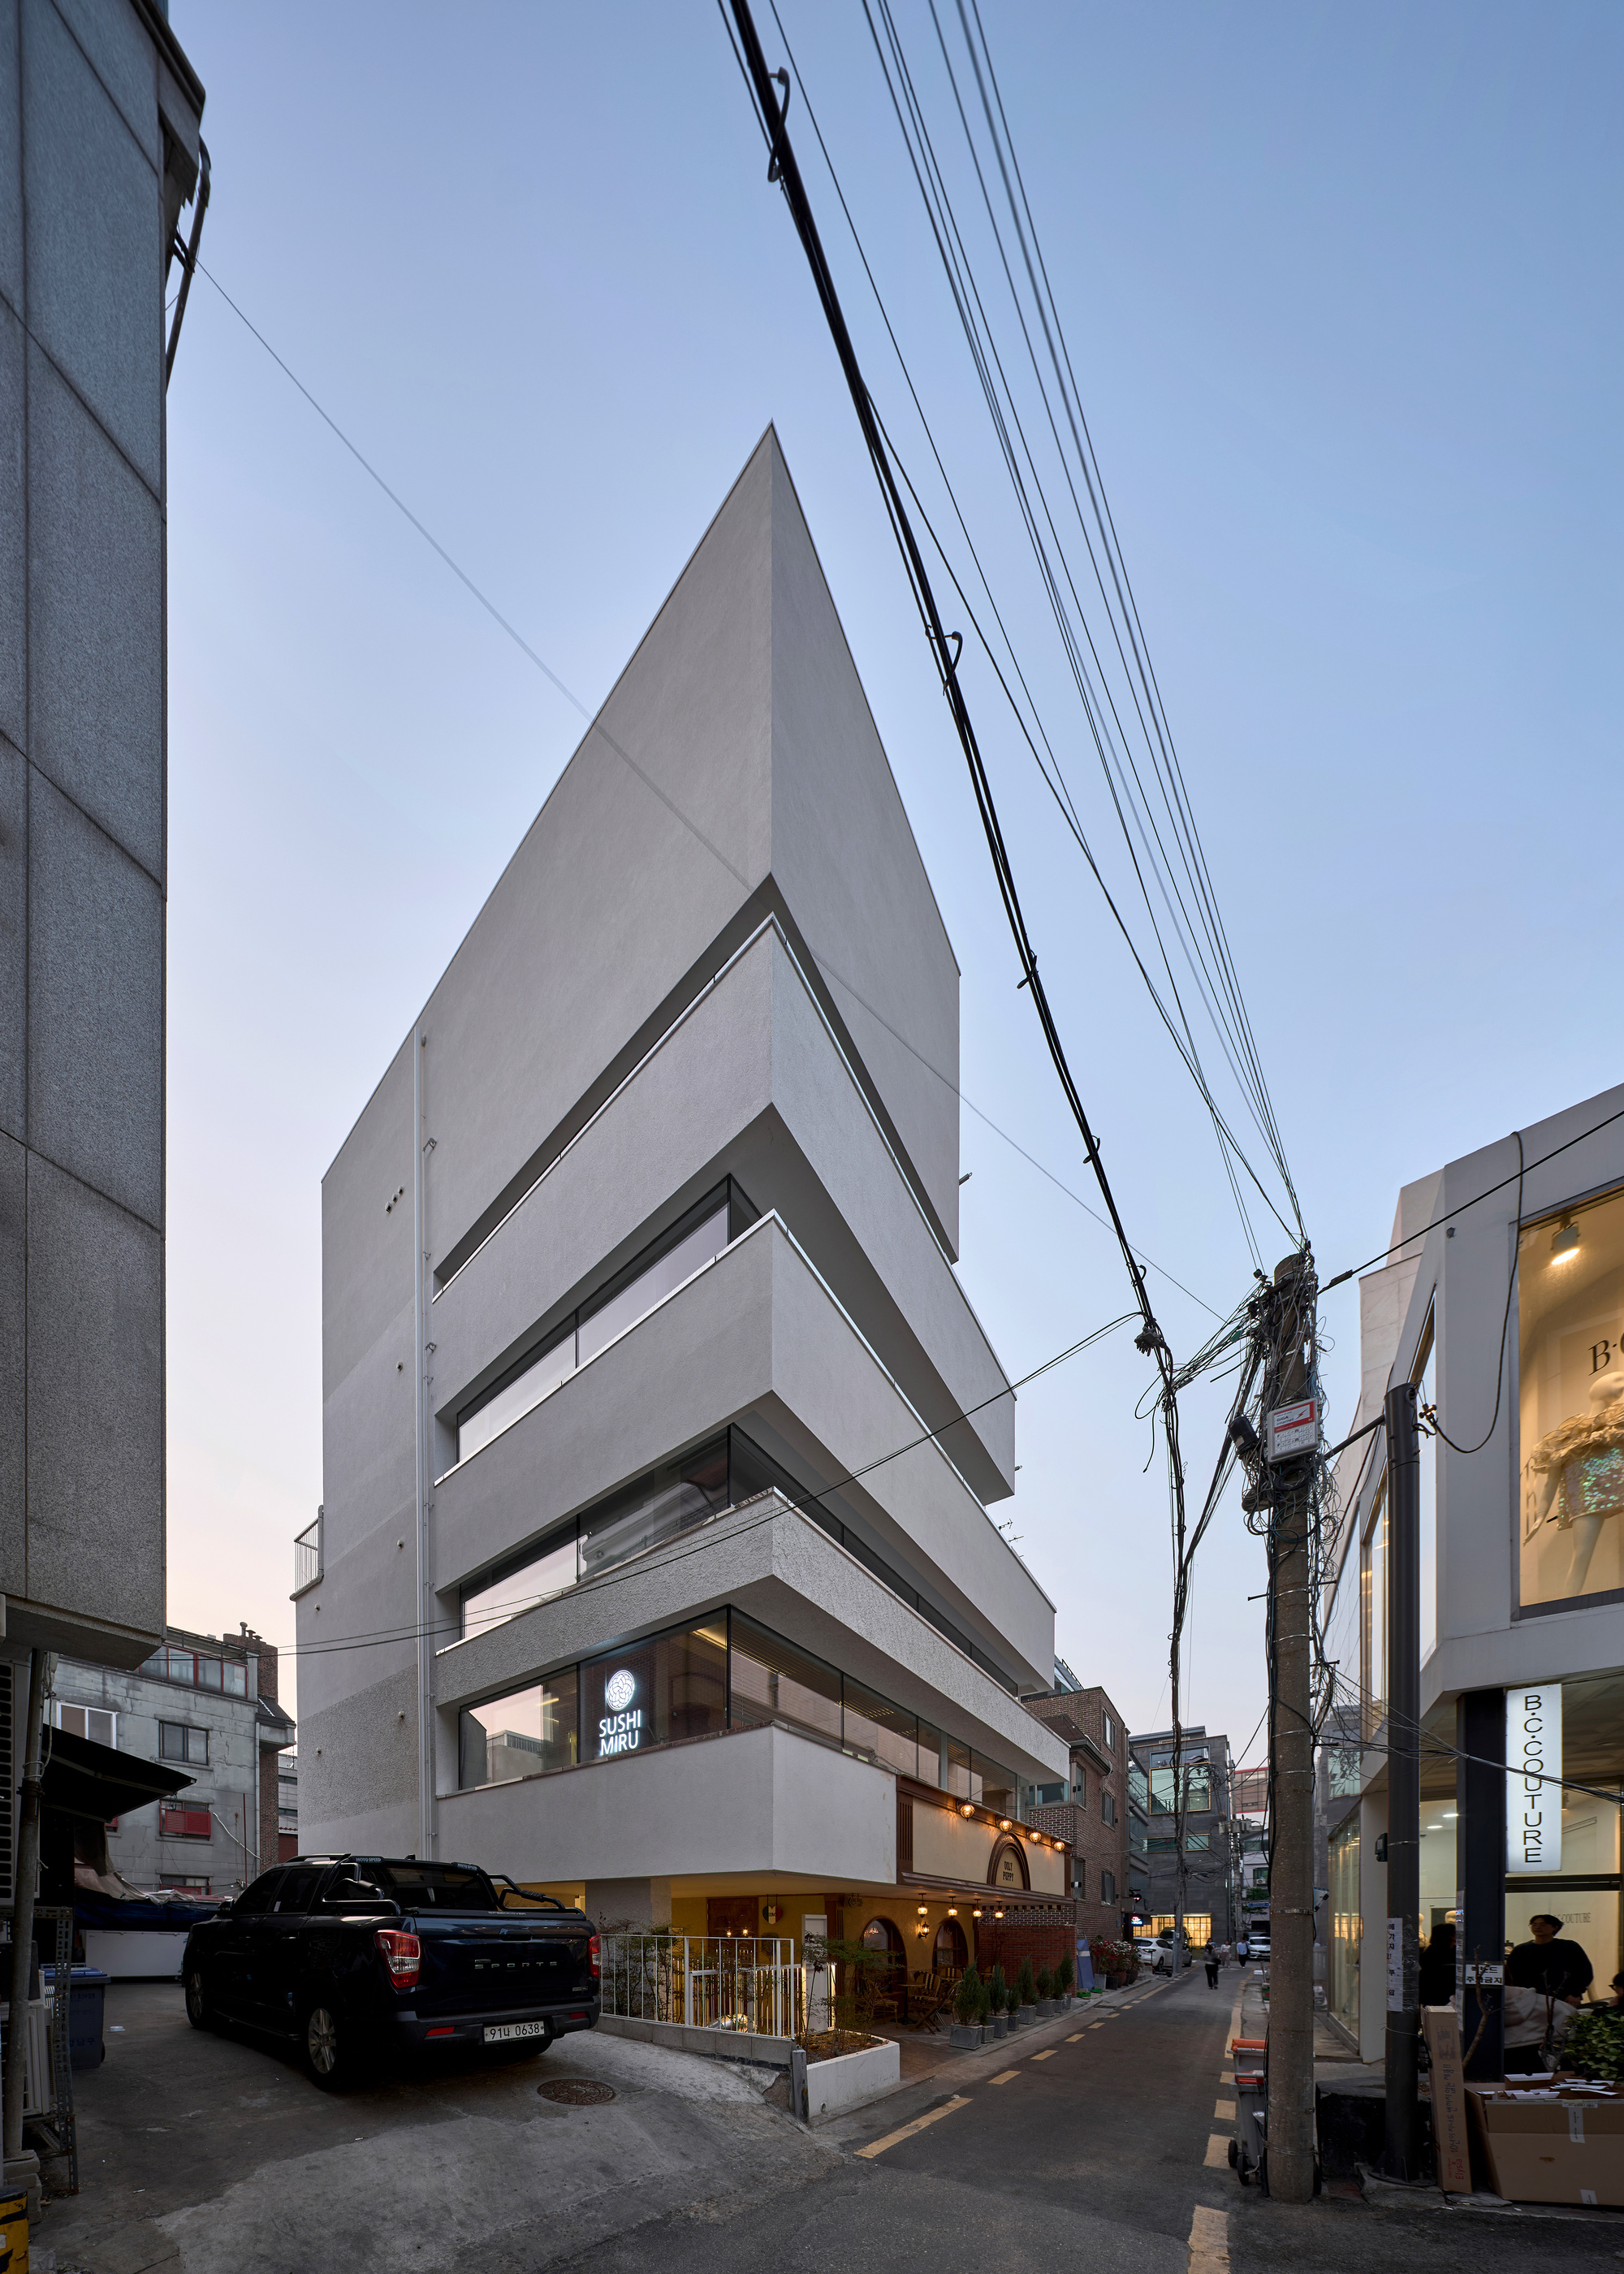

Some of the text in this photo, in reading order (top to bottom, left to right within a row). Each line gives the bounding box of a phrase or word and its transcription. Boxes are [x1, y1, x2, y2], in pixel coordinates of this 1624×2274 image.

[599, 1710, 641, 1737] SUSHI
[600, 1730, 639, 1756] MIRU
[1004, 1861, 1013, 1871] UGLY
[1003, 1871, 1013, 1882] PUPPY
[474, 1961, 558, 1969] SPORTS
[516, 2023, 540, 2036] 0638
[1453, 2158, 1466, 2180] Elysia
